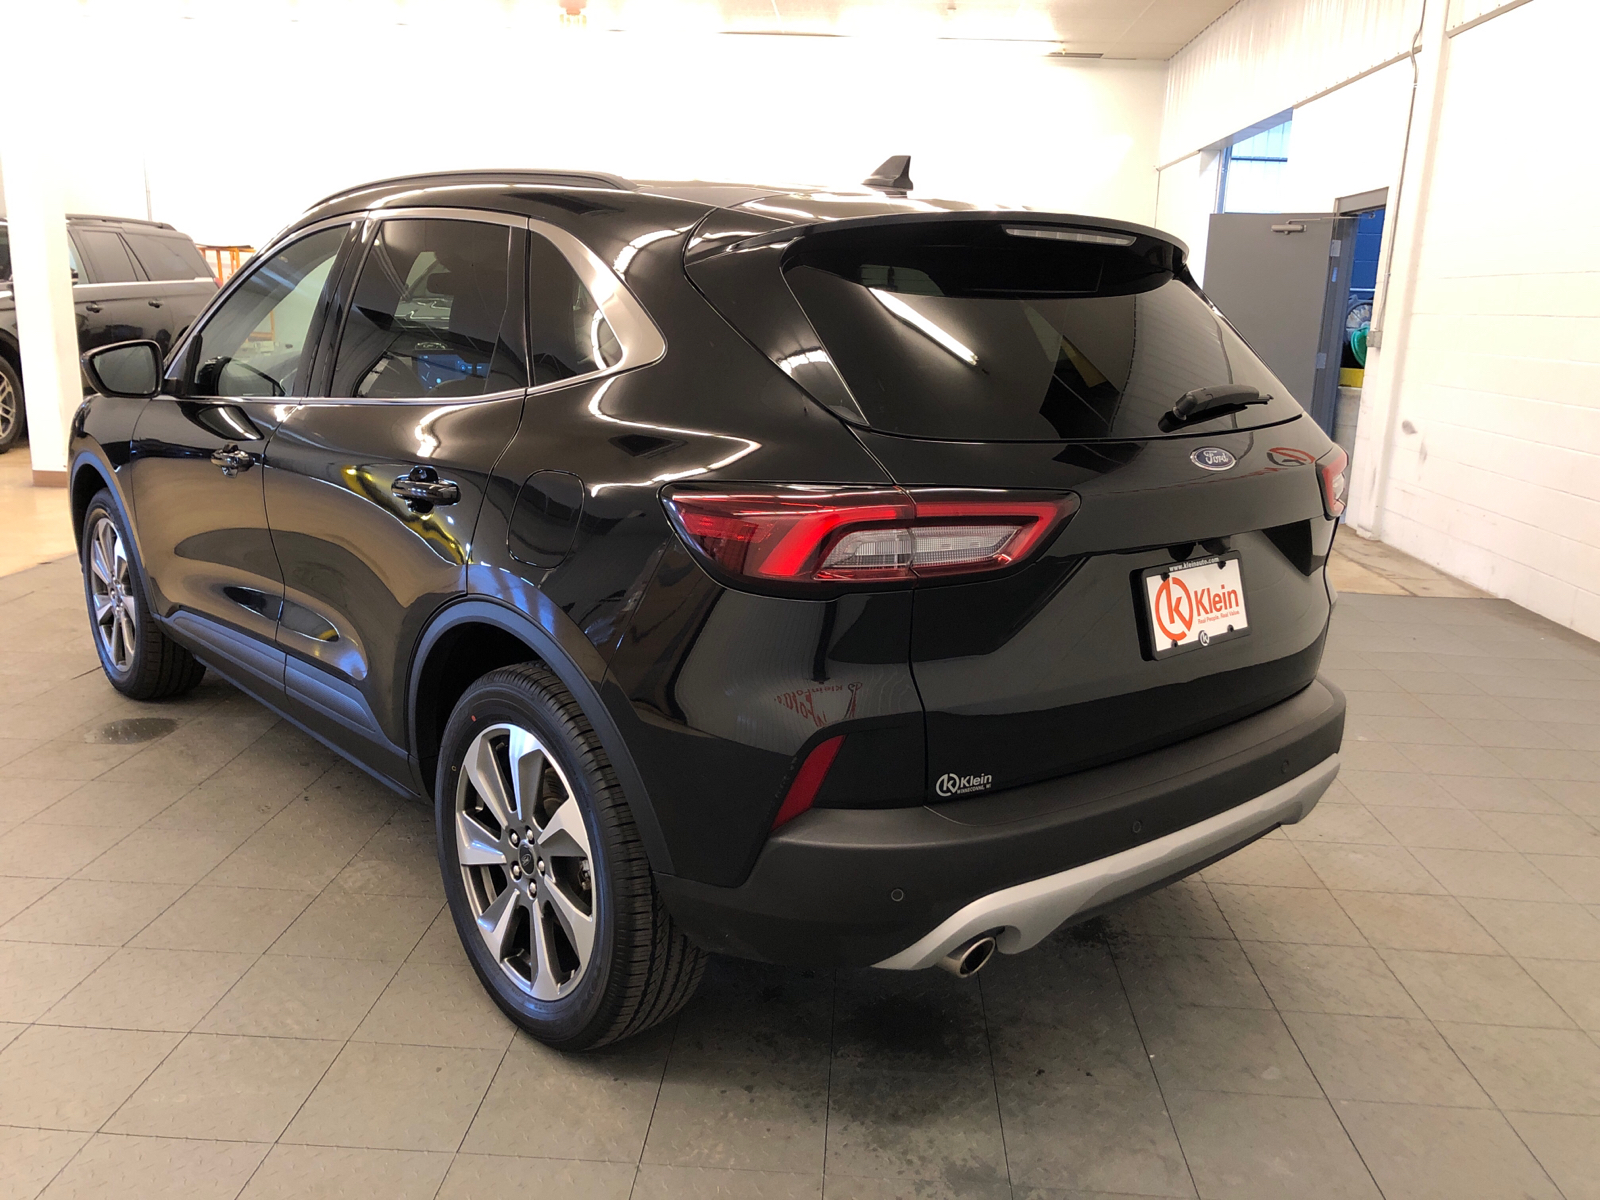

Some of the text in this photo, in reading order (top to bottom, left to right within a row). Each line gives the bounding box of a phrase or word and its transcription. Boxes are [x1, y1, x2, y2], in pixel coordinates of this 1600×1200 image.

[1203, 450, 1229, 465] Ford
[1168, 557, 1220, 572] www.kleinauto.com
[1194, 584, 1239, 617] Klein
[960, 773, 993, 788] Klein
